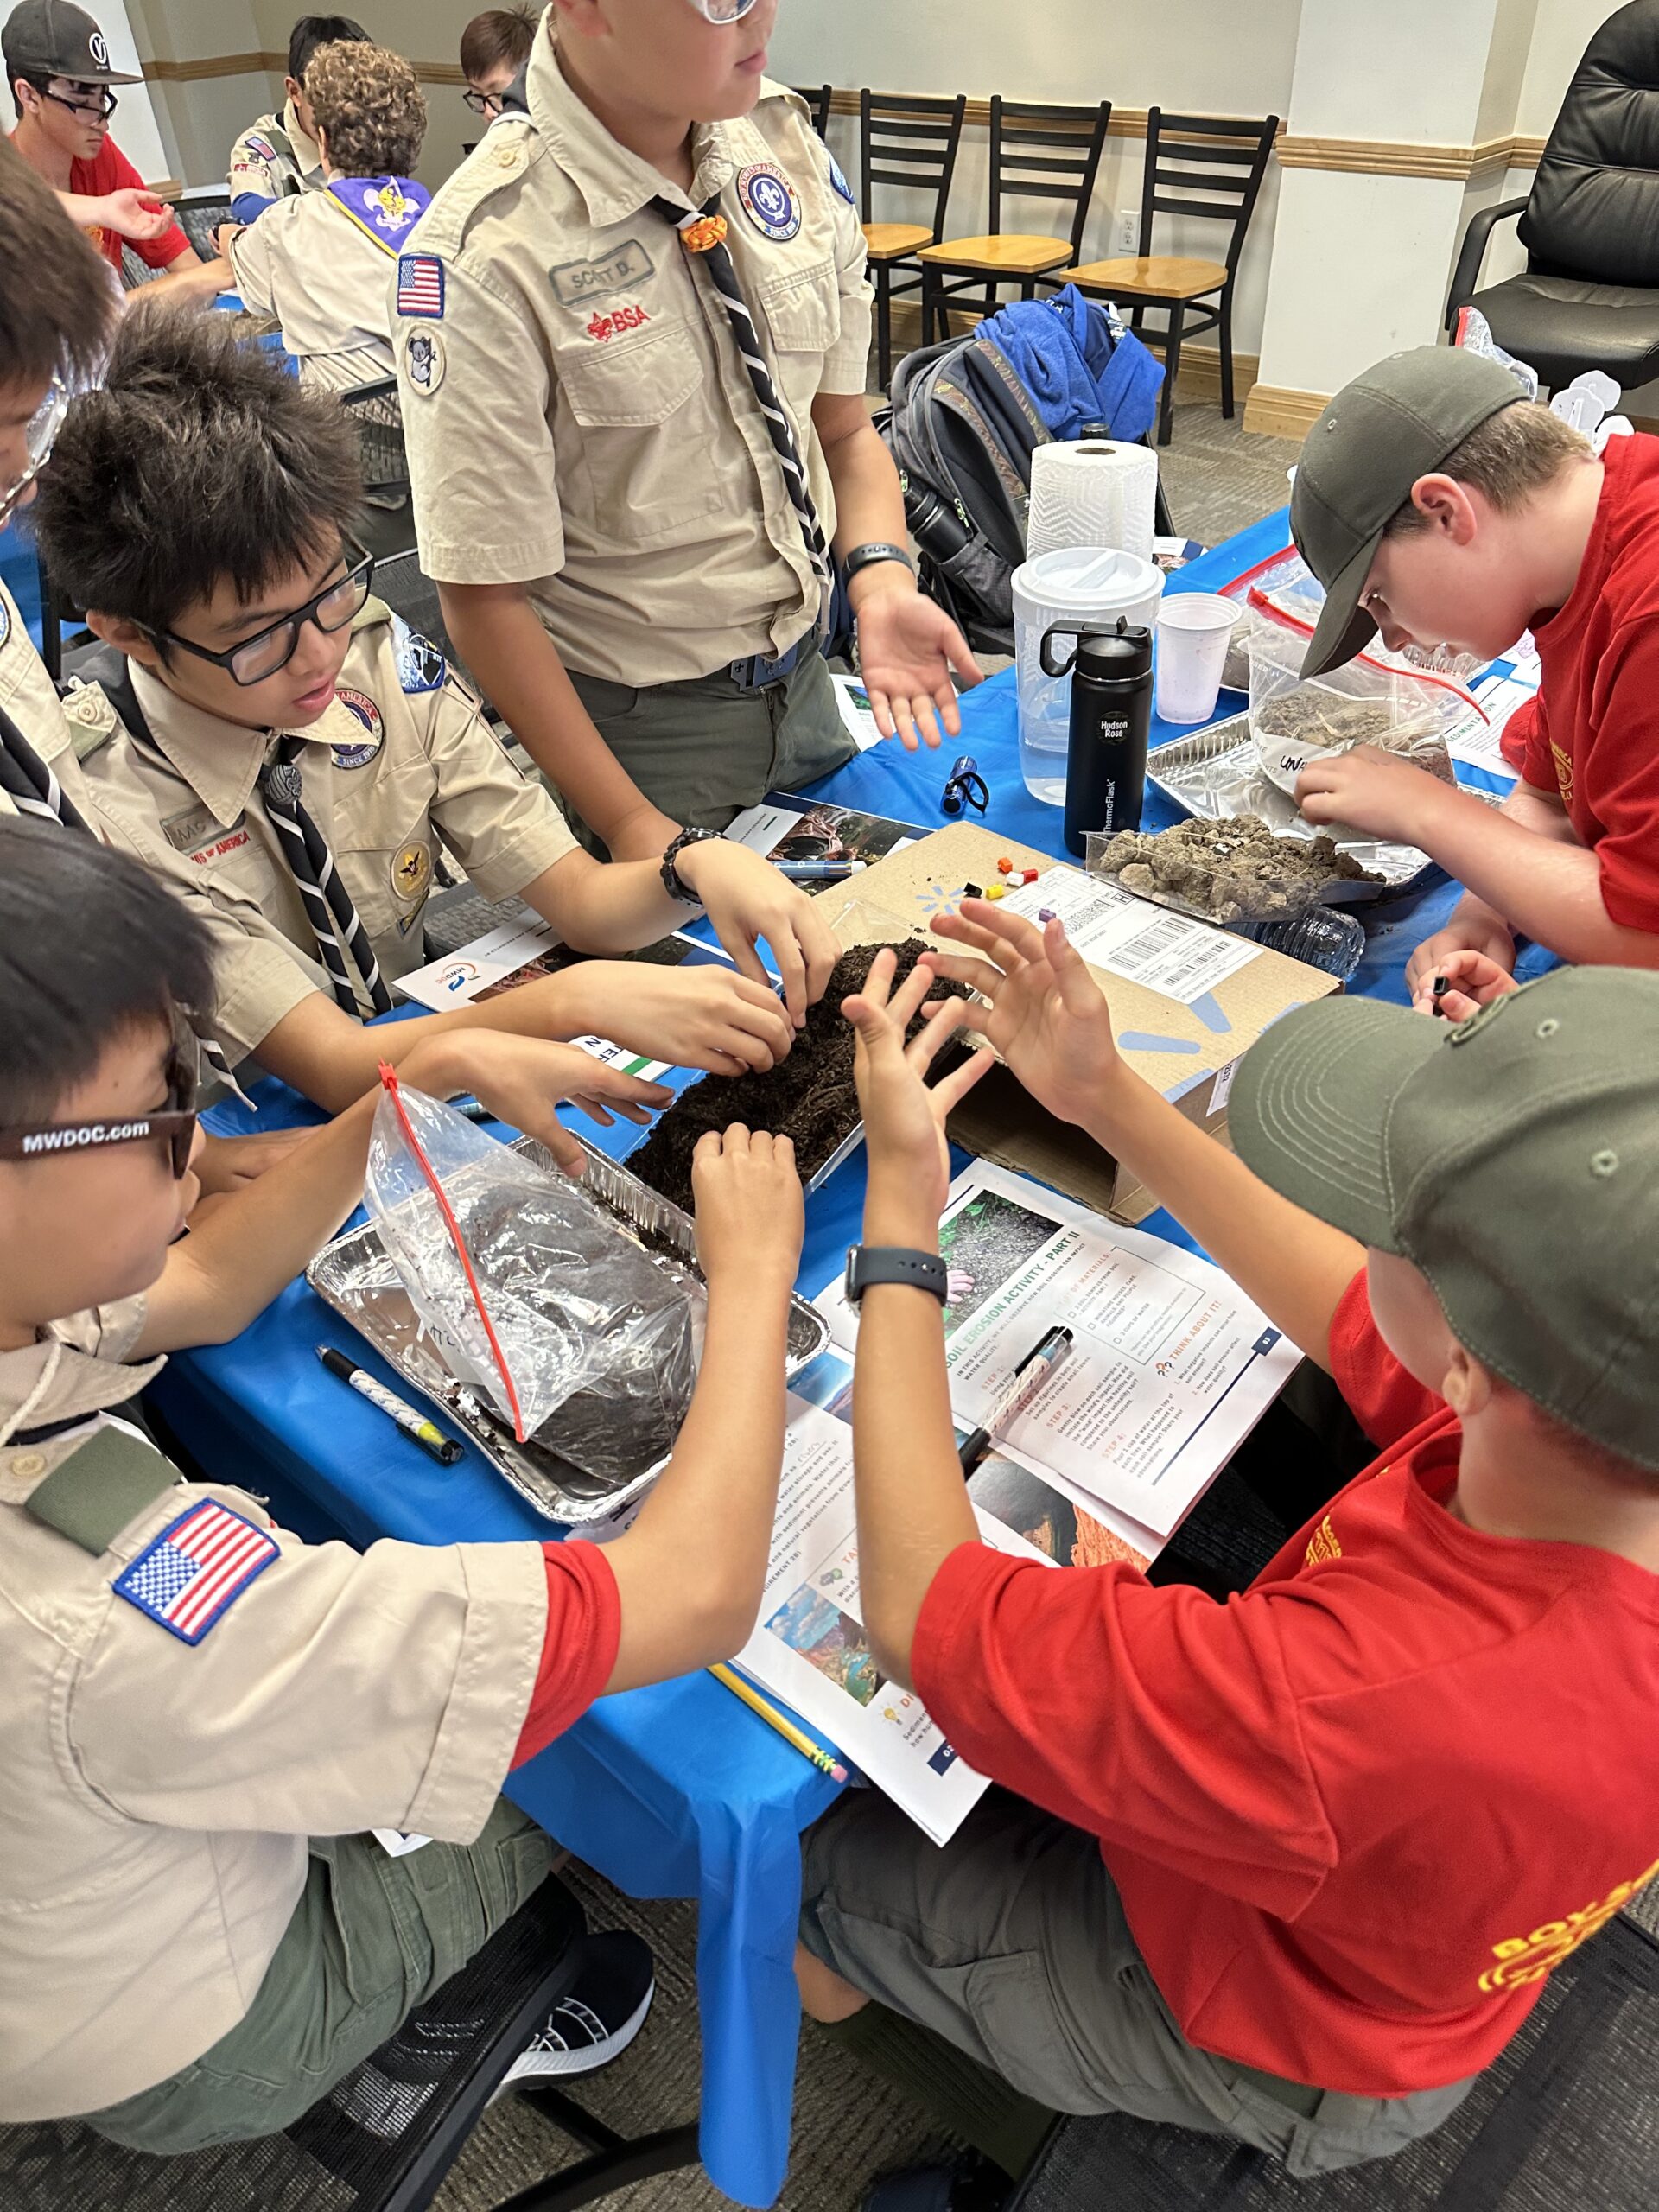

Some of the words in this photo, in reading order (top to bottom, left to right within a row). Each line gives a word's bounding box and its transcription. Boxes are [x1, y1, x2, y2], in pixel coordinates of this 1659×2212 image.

[611, 304, 652, 332] BSA
[341, 693, 374, 715] AMERICA
[1101, 721, 1128, 730] Hudson
[343, 756, 363, 766] SINCE
[215, 830, 251, 855] AMERICA
[435, 964, 465, 986] MWDOC
[22, 1122, 149, 1154] MWDOC.com
[944, 1343, 968, 1368] SOIL
[961, 1302, 1007, 1344] EROSION
[1001, 1263, 1046, 1304] ACTIVITY
[1045, 1236, 1072, 1260] PART
[1067, 1230, 1080, 1239] II
[961, 1358, 974, 1370] THIS
[1008, 1300, 1029, 1319] OBSERVE
[1027, 1291, 1039, 1300] HOW
[1036, 1281, 1047, 1292] SOIL
[1046, 1264, 1065, 1282] EROSION
[1062, 1256, 1072, 1265] CAN
[1070, 1243, 1086, 1257] IMPACT
[1167, 1336, 1192, 1360] THINK
[1187, 1312, 1213, 1337] ABOUT
[1208, 1300, 1223, 1312] IT!
[963, 1363, 982, 1380] WATER
[980, 1372, 999, 1389] STEP
[995, 1364, 1007, 1373] 1:
[1056, 1418, 1072, 1433] Gently
[1069, 1407, 1082, 1419] blow
[1084, 1389, 1096, 1402] each
[1093, 1382, 1104, 1391] soil
[1101, 1366, 1118, 1382] sample
[1064, 1420, 1082, 1438] imitate
[1077, 1412, 1089, 1421] the
[1111, 1372, 1123, 1383] How
[1119, 1364, 1129, 1374] did
[1071, 1433, 1082, 1442] the
[1090, 1402, 1108, 1419] impact
[1103, 1395, 1115, 1404] the
[1110, 1379, 1128, 1396] healthy
[1124, 1370, 1135, 1380] soil
[1078, 1423, 1101, 1446] compared
[1103, 1410, 1113, 1419] the
[1109, 1389, 1131, 1411] unhealthy
[1127, 1378, 1140, 1390] soil?
[1045, 1409, 1065, 1428] STEP
[1060, 1402, 1071, 1411] 3:
[1086, 1436, 1102, 1451] Share
[1098, 1426, 1110, 1437] your
[770, 1531, 784, 1546] with
[782, 1507, 807, 1533] sediment
[804, 1484, 828, 1509] prevents
[825, 1464, 847, 1486] animals
